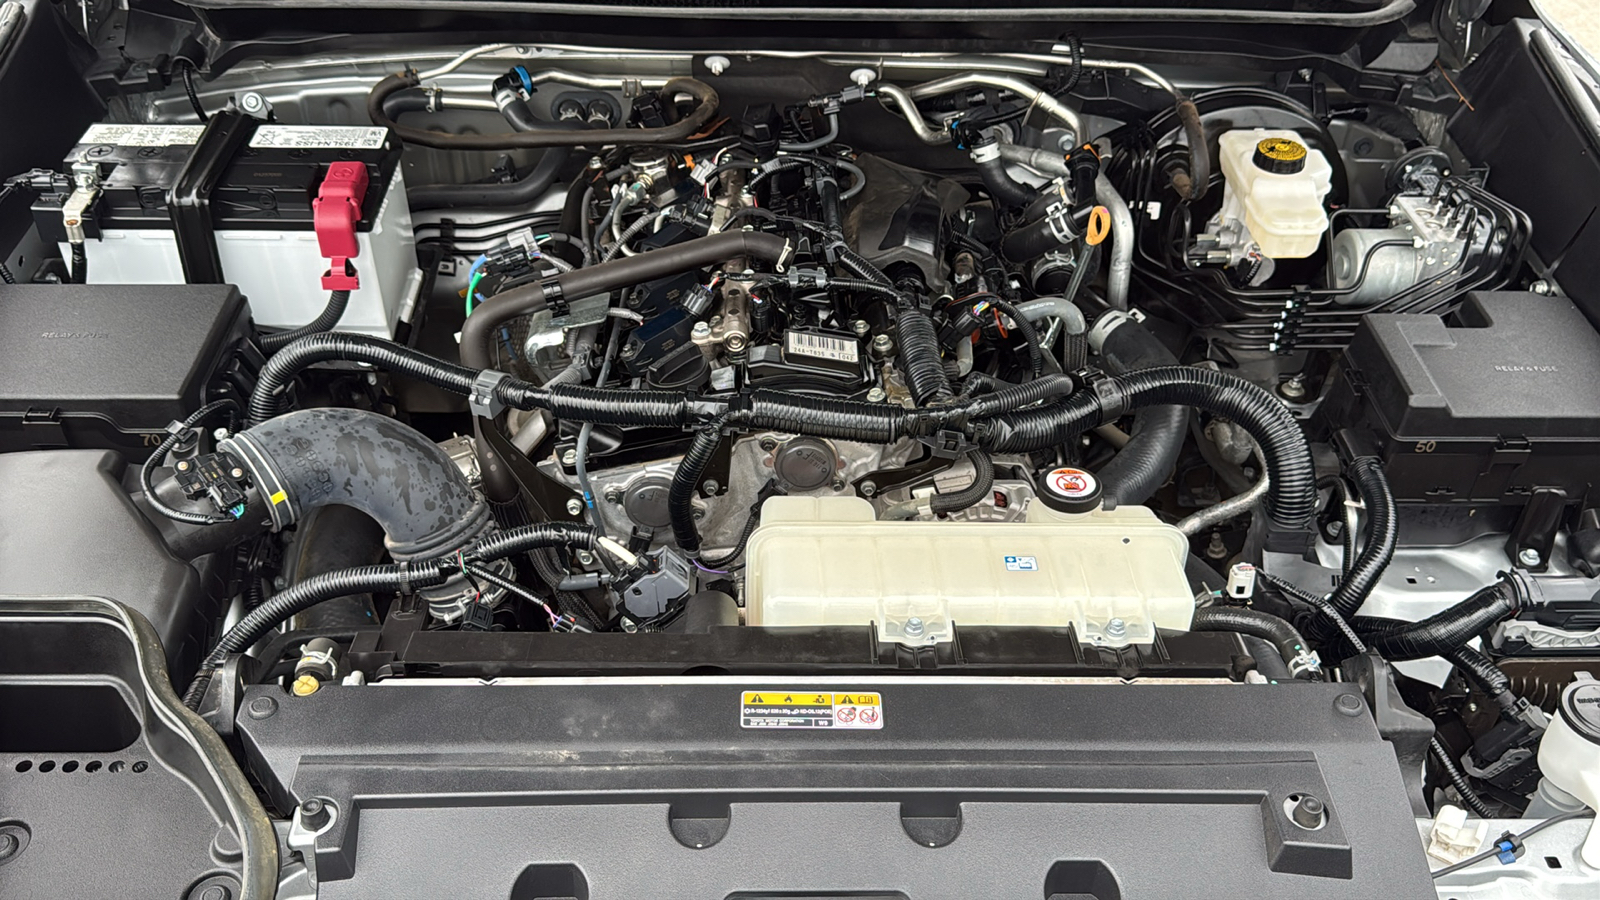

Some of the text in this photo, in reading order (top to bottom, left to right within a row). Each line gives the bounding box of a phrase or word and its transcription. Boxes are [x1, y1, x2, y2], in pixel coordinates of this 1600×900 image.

[1493, 365, 1524, 373] RELAY
[1533, 365, 1559, 373] FUSE
[139, 434, 161, 447] 70
[1414, 440, 1437, 453] 50
